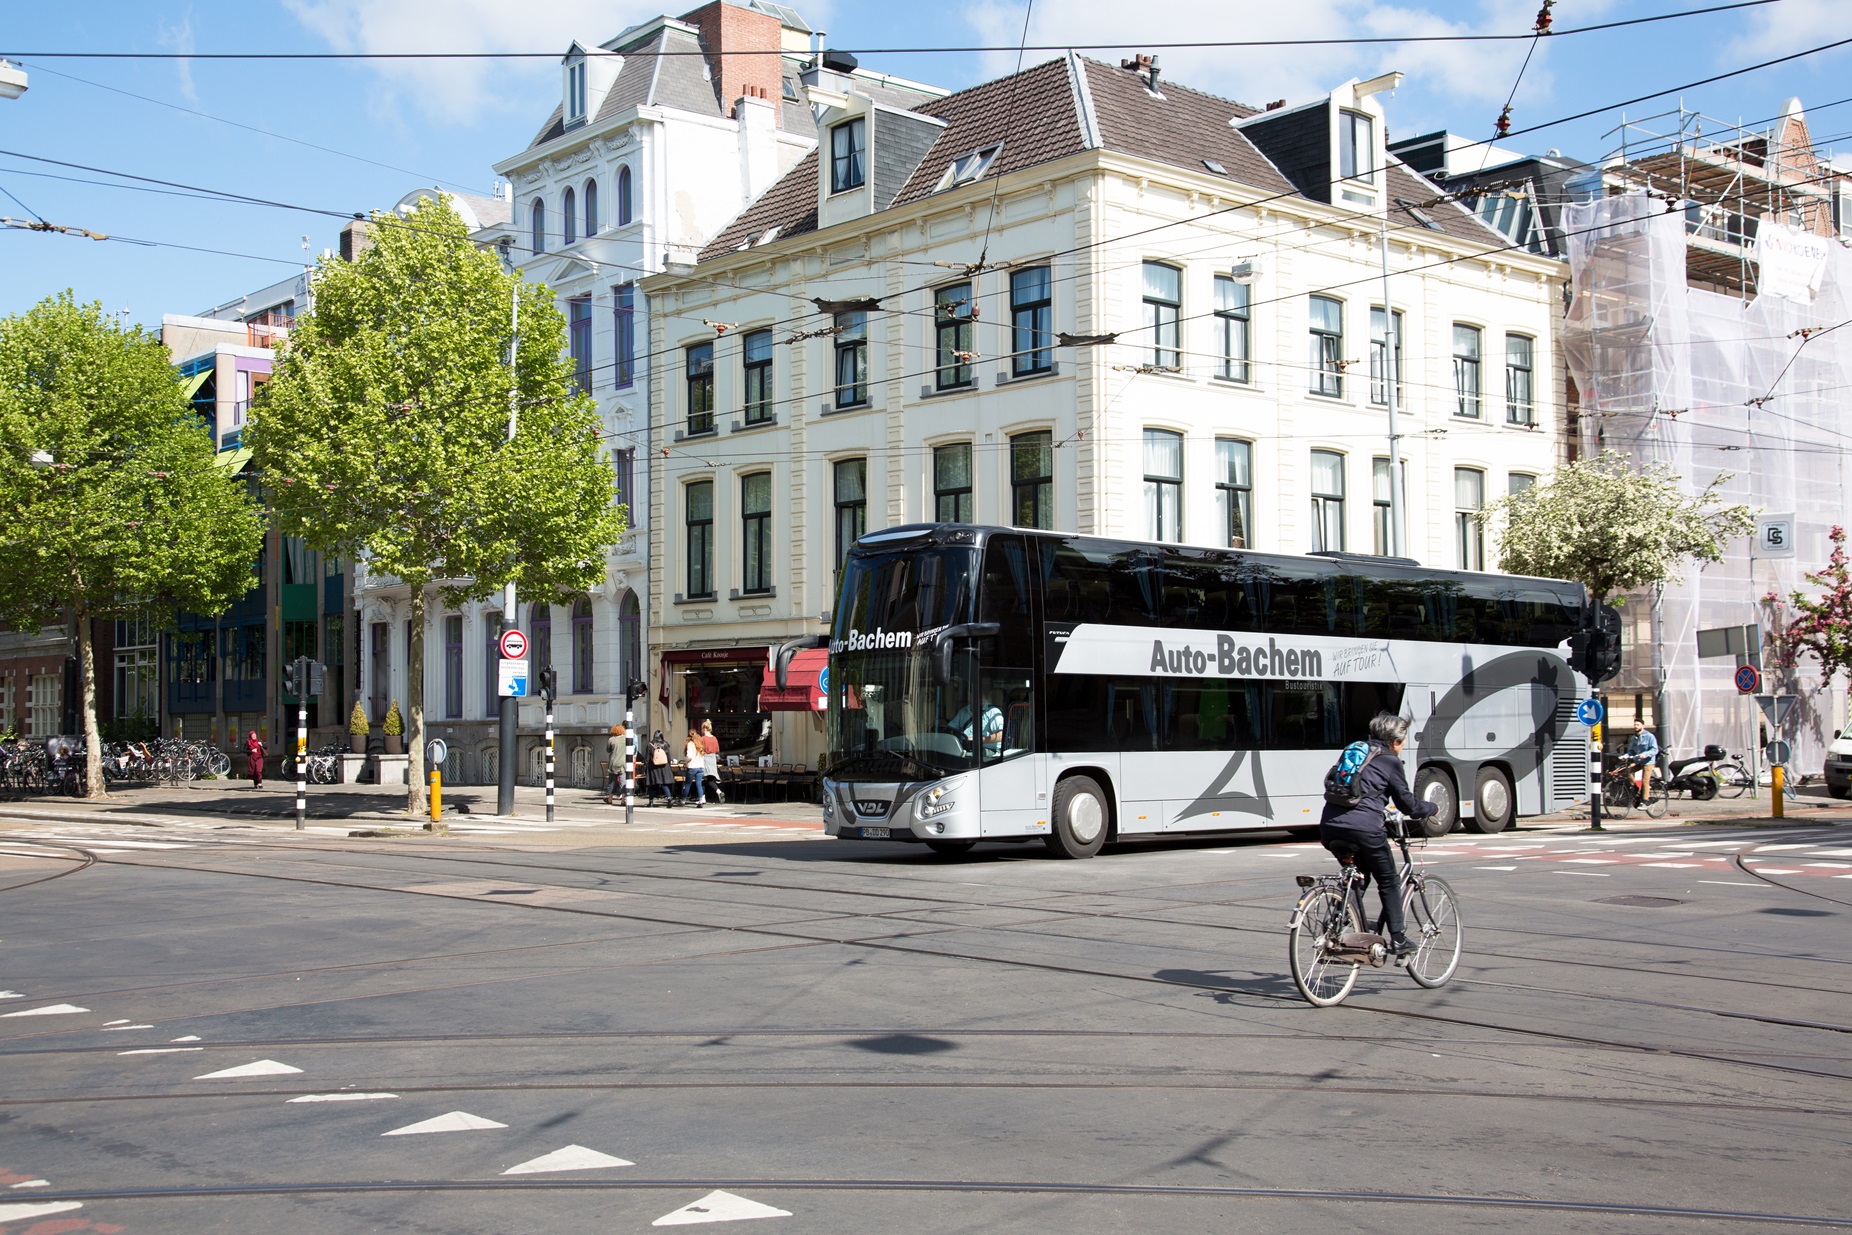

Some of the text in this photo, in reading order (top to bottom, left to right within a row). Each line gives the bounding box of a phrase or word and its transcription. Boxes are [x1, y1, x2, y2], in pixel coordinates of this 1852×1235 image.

[1150, 633, 1323, 677] Auto-Bachem
[1333, 659, 1352, 677] AUF
[1285, 680, 1323, 691] Bustouristik
[857, 802, 885, 814] VDL
